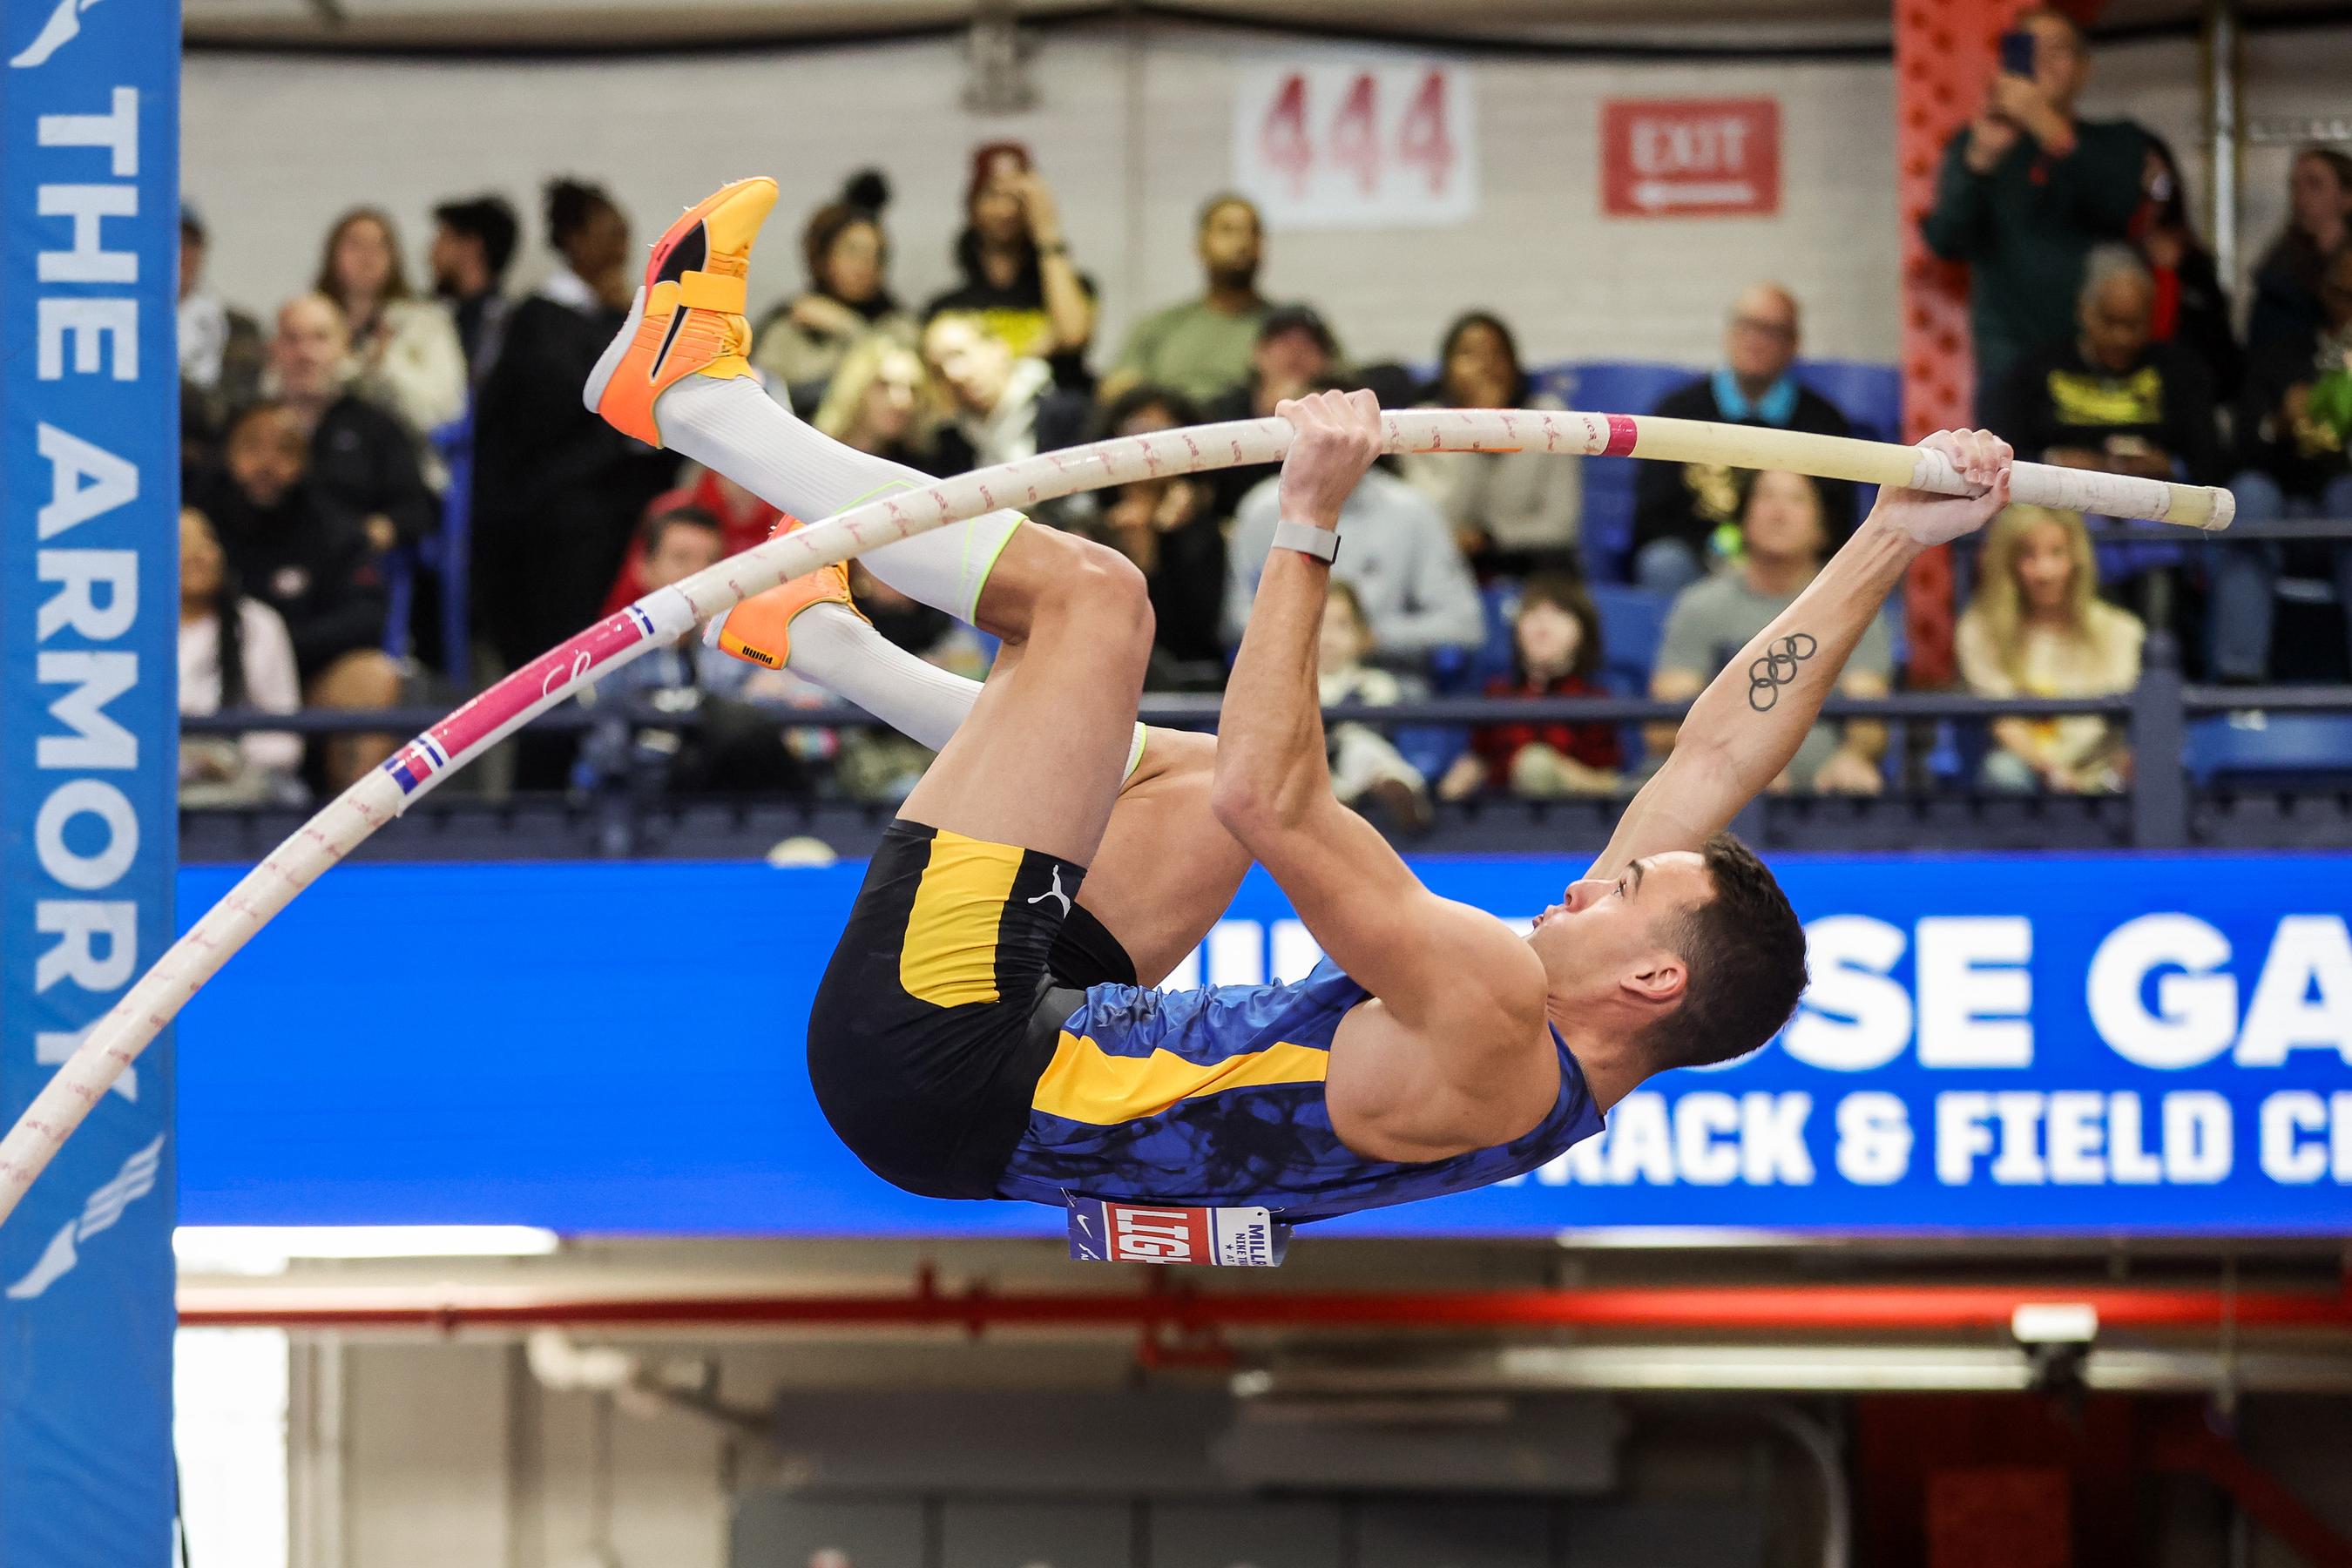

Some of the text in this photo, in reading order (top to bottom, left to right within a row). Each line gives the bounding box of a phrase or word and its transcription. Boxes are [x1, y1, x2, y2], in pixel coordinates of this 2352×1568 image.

[1258, 70, 1456, 200] 444
[1630, 117, 1751, 175] EXIT
[37, 86, 139, 381] THE
[1836, 1090, 1915, 1186] &
[1935, 1090, 2234, 1186] FIELD
[1227, 1254, 1235, 1263] AT
[1235, 1233, 1247, 1255] NIKE
